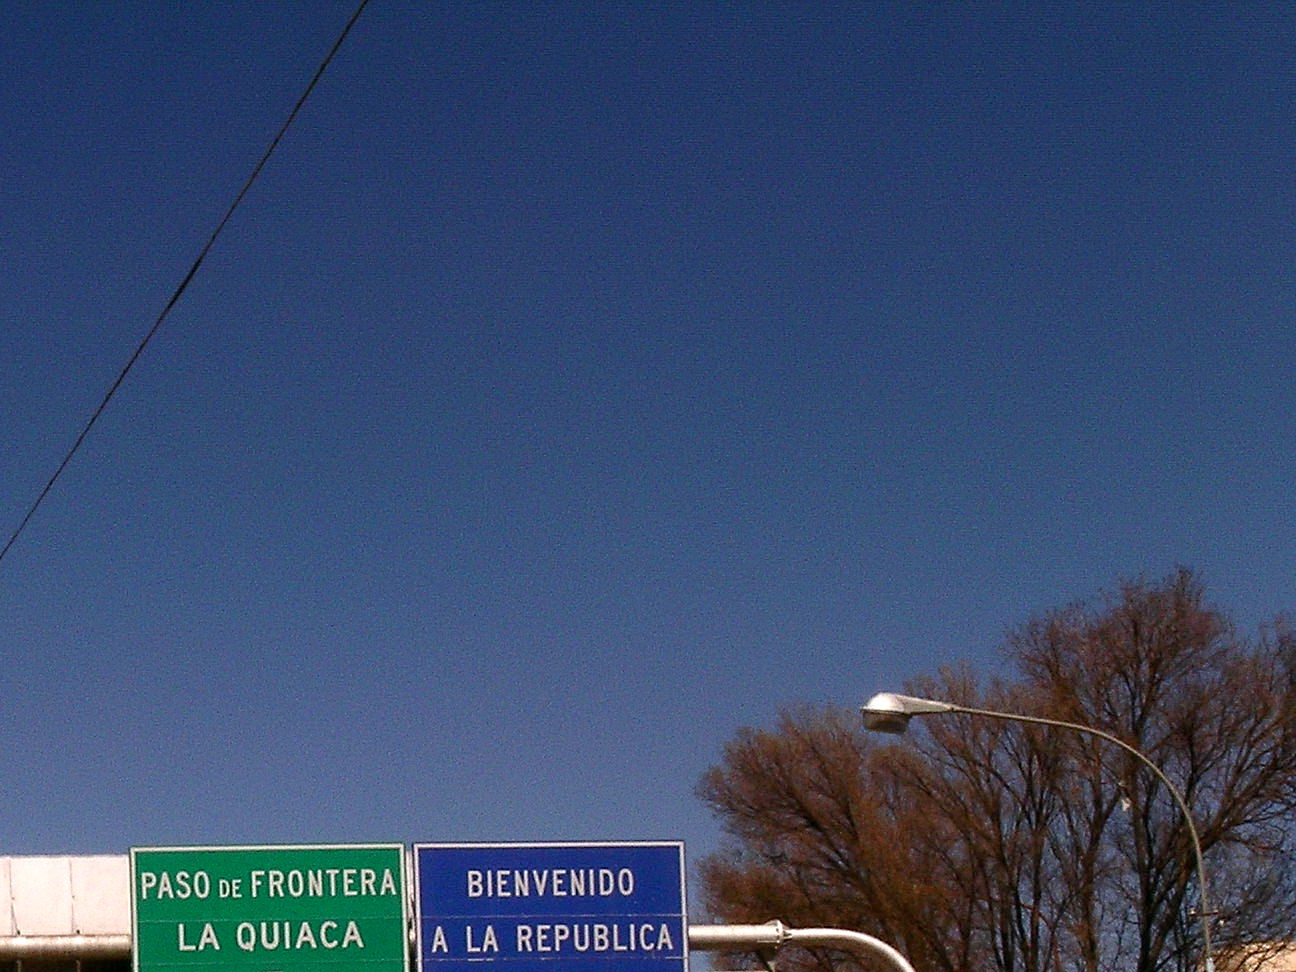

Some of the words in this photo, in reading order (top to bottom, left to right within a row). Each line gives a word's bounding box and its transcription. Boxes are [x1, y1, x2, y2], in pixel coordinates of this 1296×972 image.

[141, 870, 209, 900] PASO
[219, 879, 242, 898] DE
[251, 868, 397, 898] FRONTERA
[468, 868, 635, 898] BIENVENIDO
[178, 922, 221, 952] LA
[237, 921, 365, 952] QUIACA
[431, 925, 448, 954] A
[468, 924, 499, 953] LA
[517, 923, 674, 953] REPUBLICA
